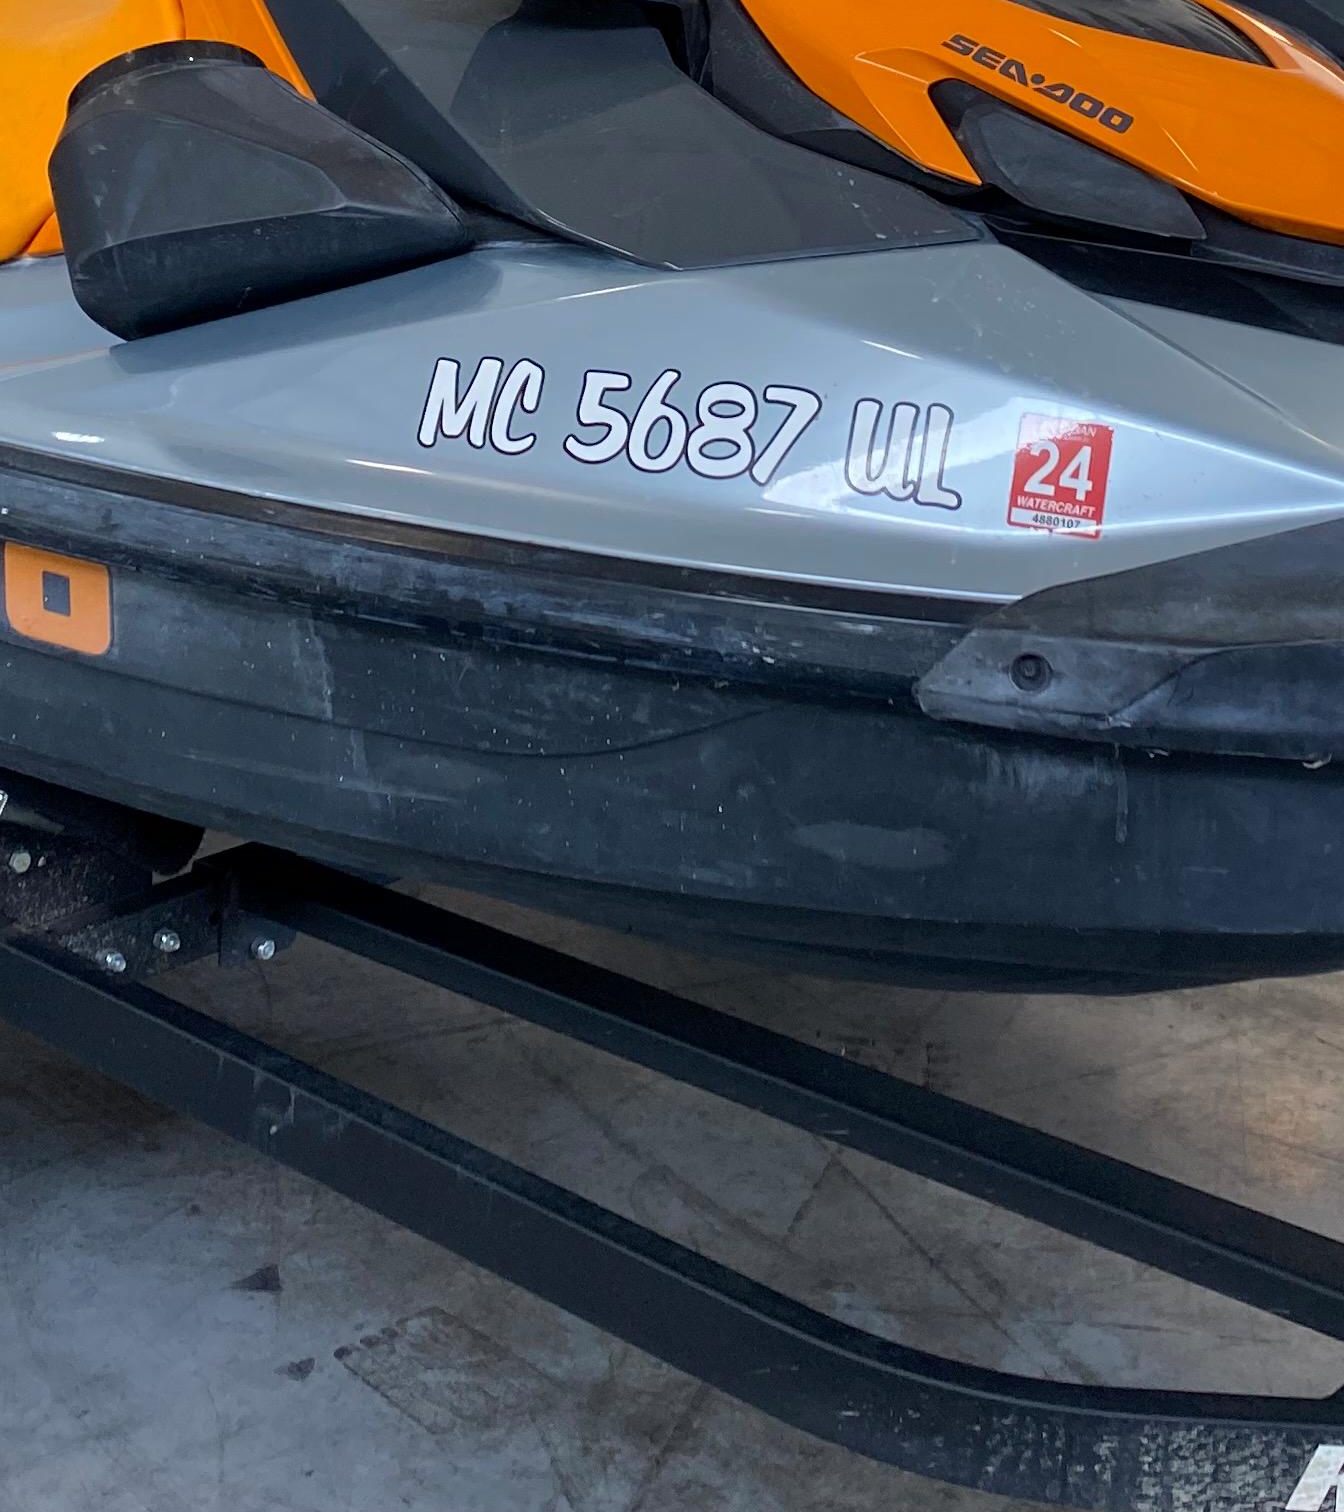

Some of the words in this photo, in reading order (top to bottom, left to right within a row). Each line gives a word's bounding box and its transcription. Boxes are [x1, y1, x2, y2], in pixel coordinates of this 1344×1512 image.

[417, 356, 546, 456] MC
[562, 368, 822, 487] 5687
[843, 397, 963, 510] UL
[1023, 439, 1094, 502] 24
[1016, 495, 1097, 519] WATERCRAFT
